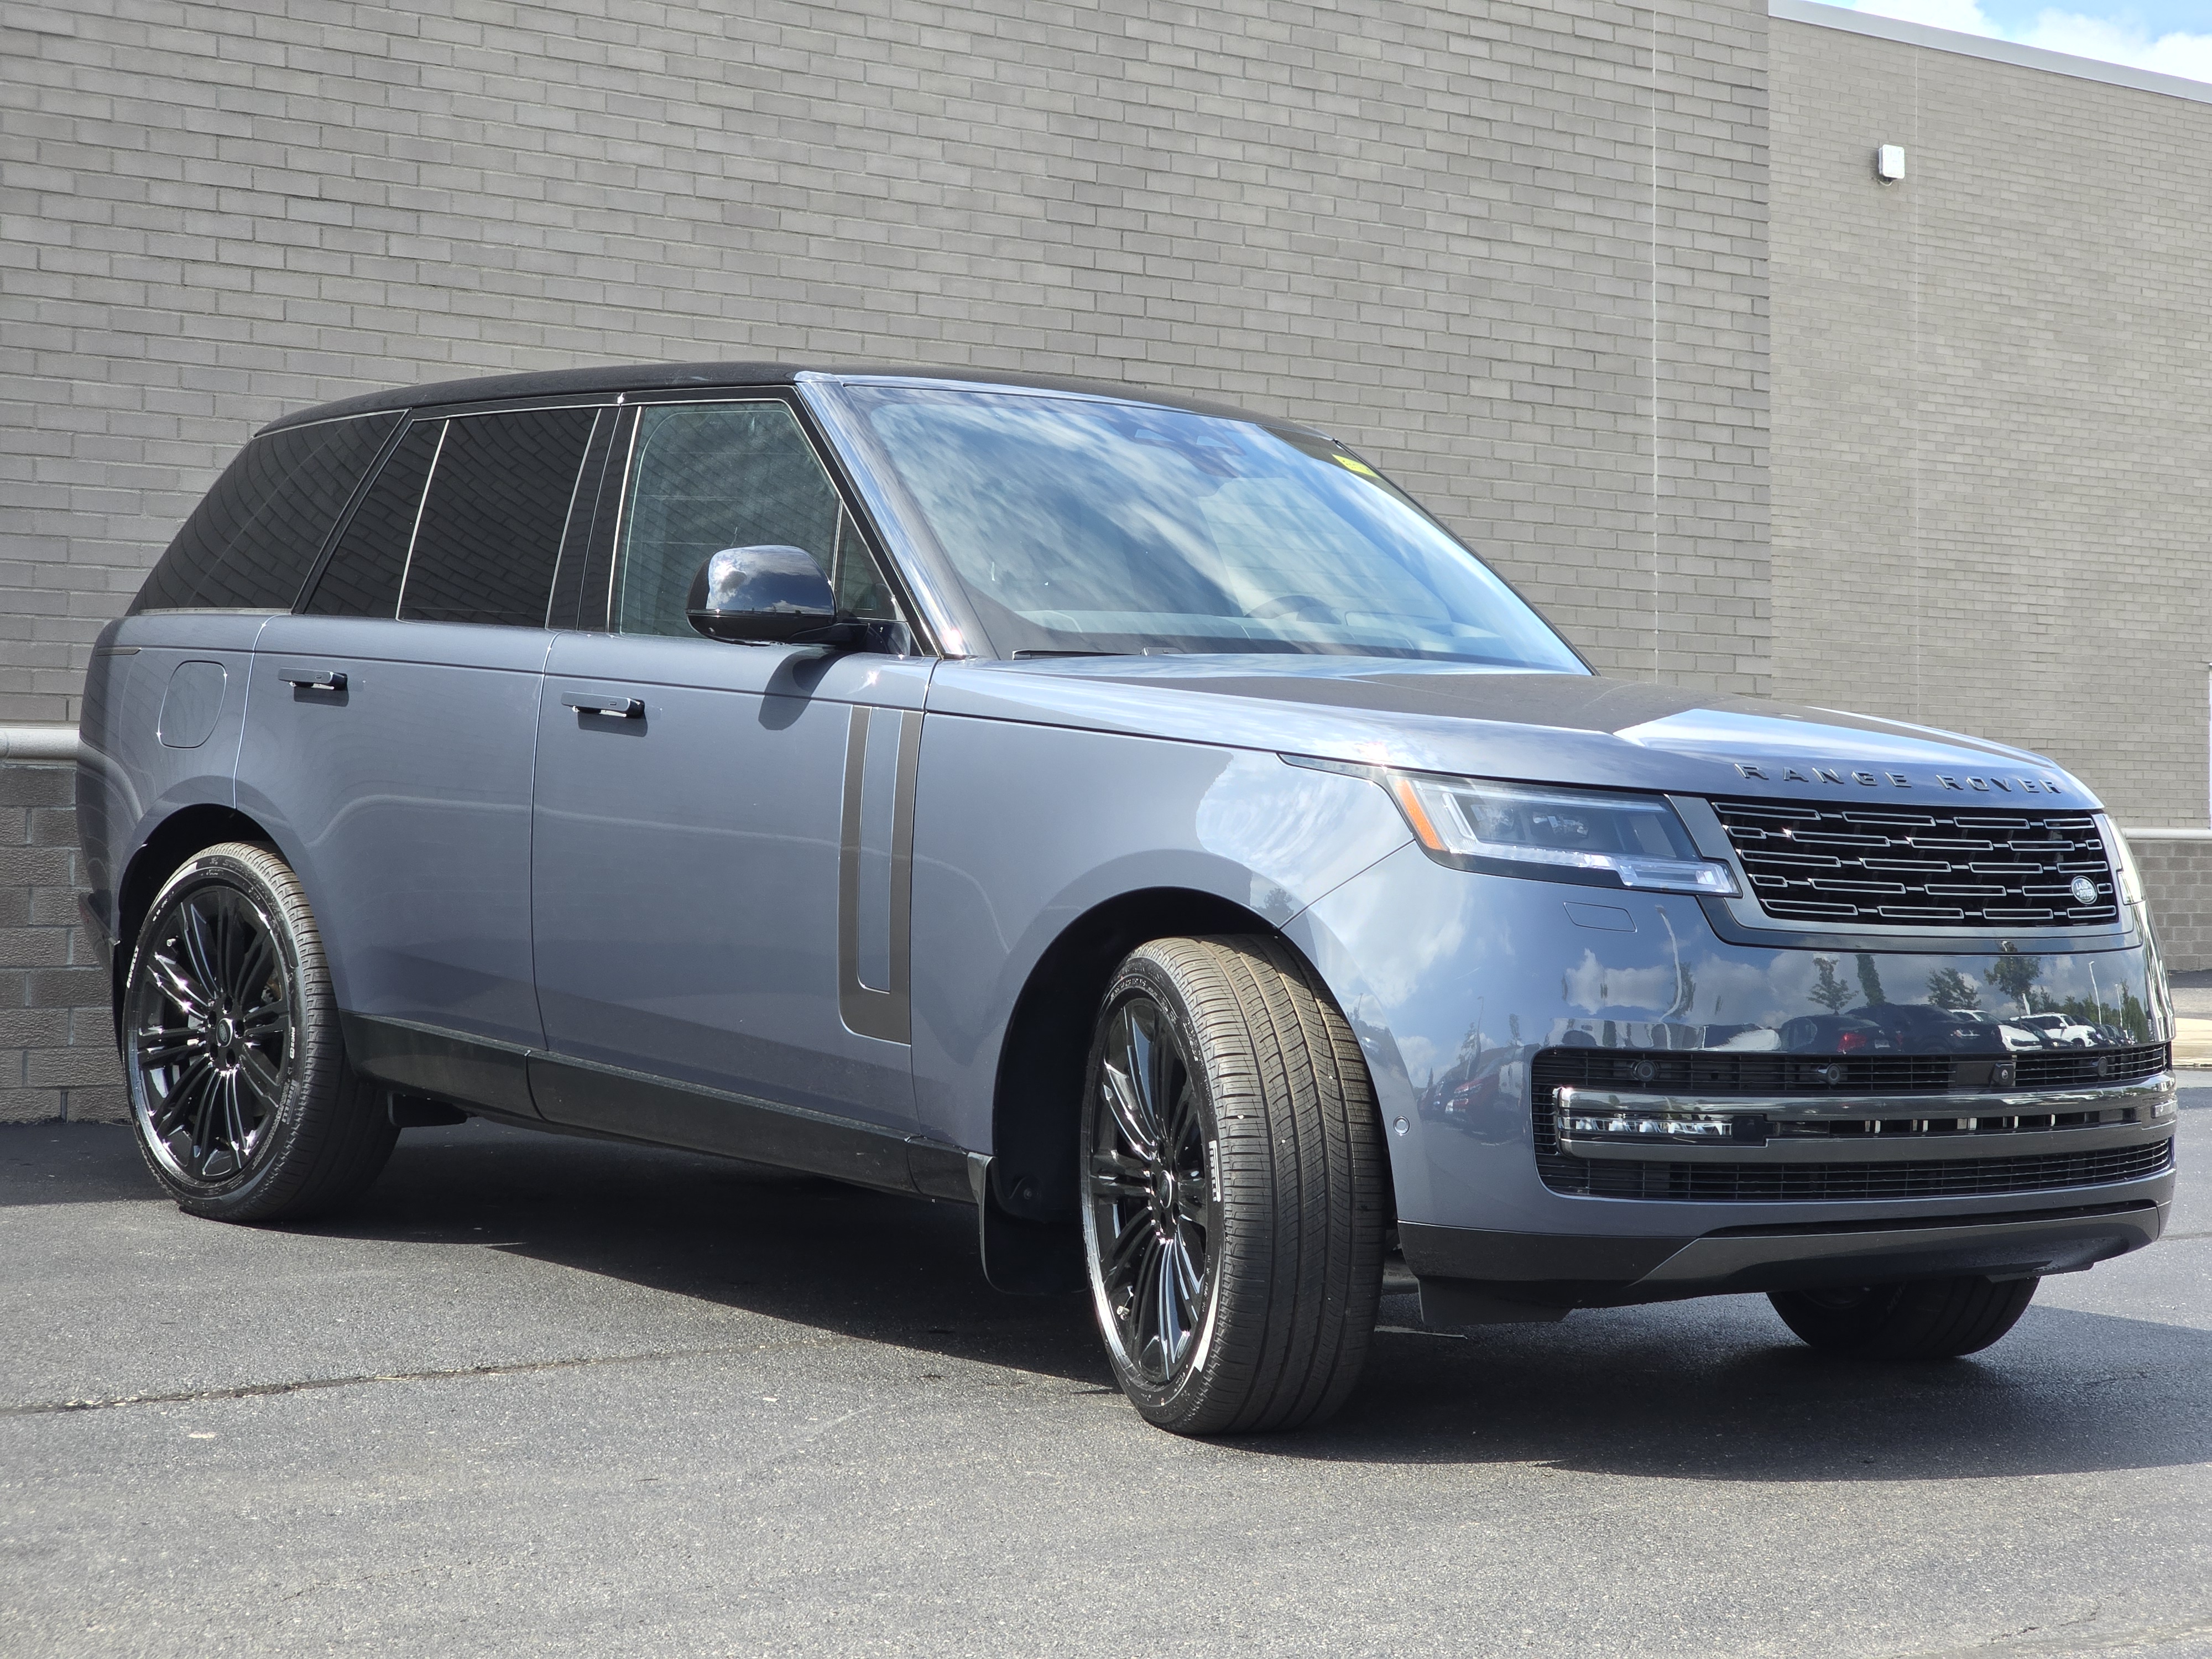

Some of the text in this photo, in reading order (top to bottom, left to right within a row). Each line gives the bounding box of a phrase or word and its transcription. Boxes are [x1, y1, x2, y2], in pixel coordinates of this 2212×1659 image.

[1734, 763, 2062, 793] RANGE ROVER
[281, 1079, 299, 1124] PIRELLI
[1209, 1140, 1221, 1202] PIRELLI
